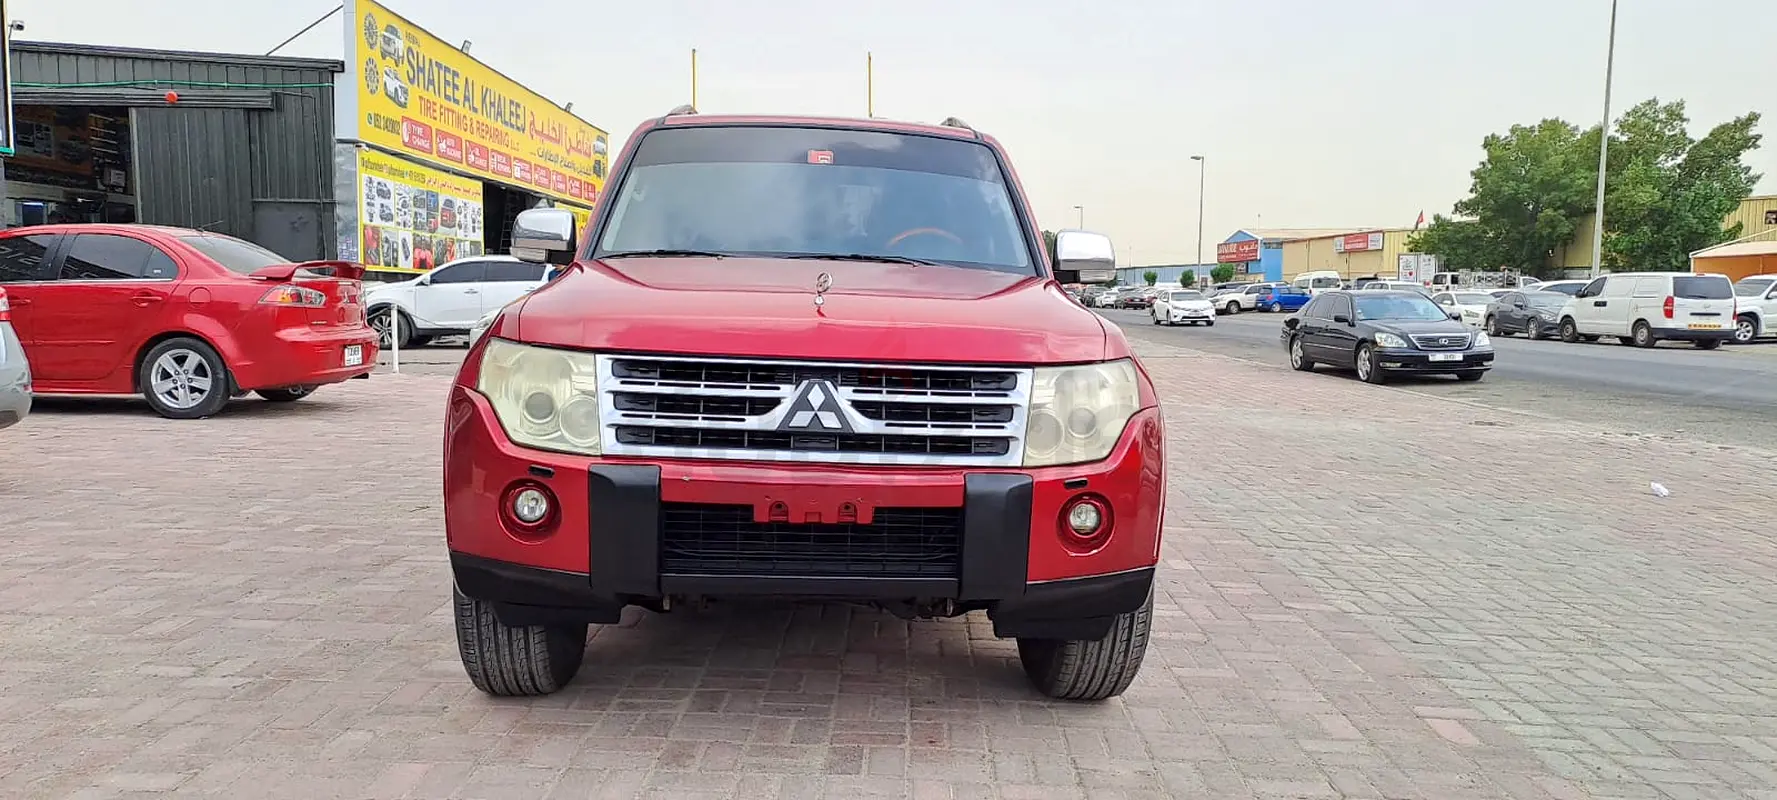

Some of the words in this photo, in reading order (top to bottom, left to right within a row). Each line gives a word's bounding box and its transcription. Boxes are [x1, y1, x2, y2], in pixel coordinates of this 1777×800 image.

[406, 46, 460, 105] SHATEE
[463, 77, 479, 113] AL
[481, 85, 527, 134] KHALEEJ
[418, 95, 438, 121] TIRE
[440, 103, 468, 133] FITTING
[475, 120, 510, 148] REPAIRING
